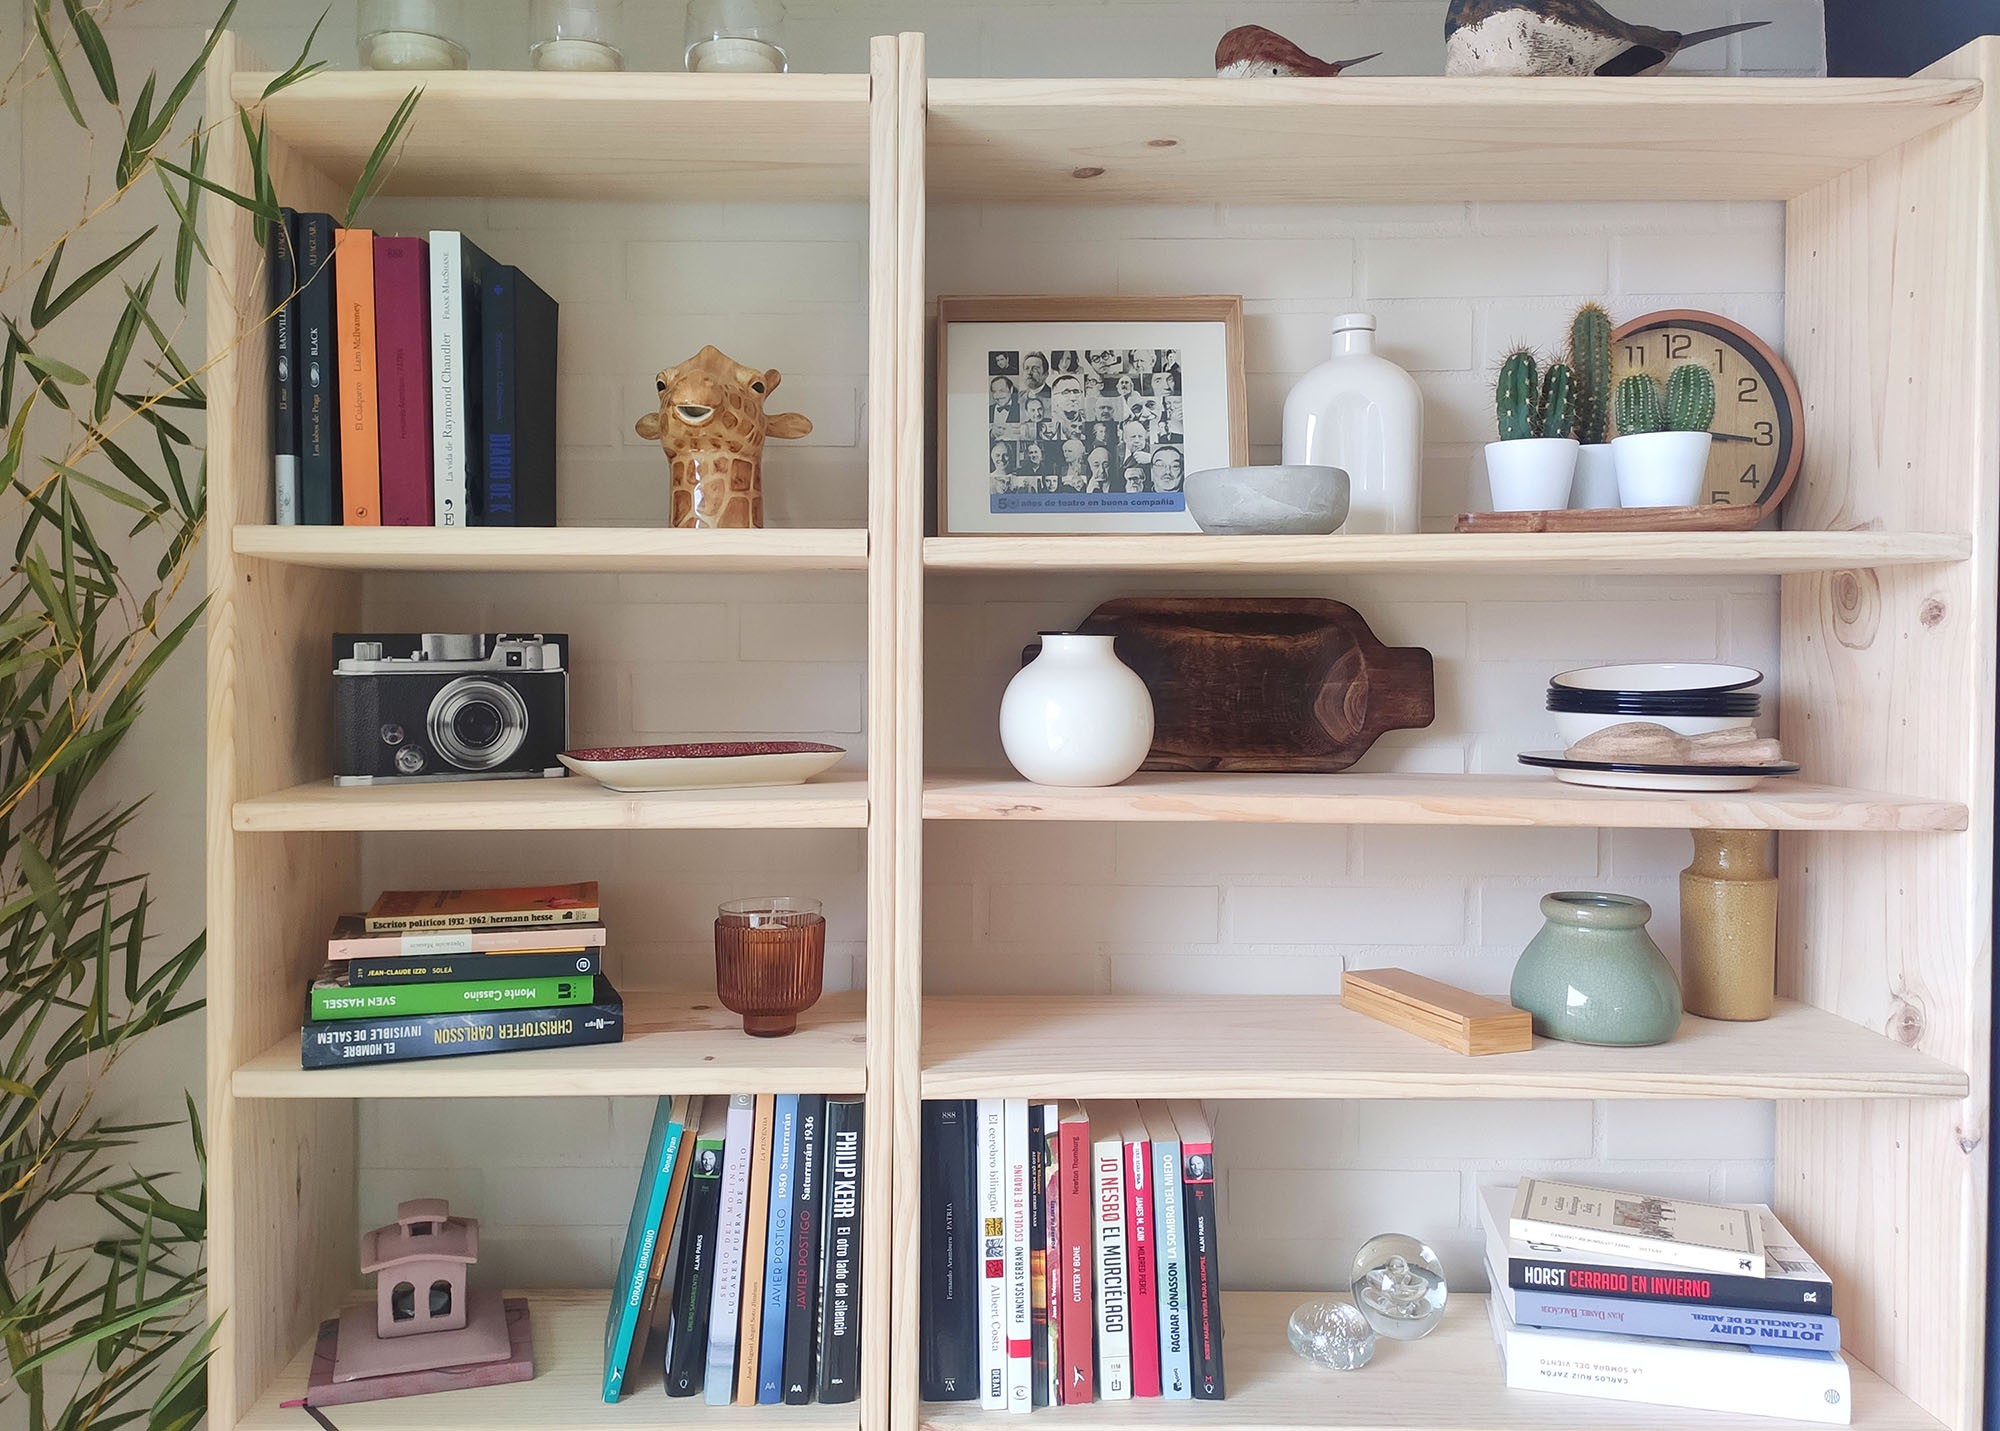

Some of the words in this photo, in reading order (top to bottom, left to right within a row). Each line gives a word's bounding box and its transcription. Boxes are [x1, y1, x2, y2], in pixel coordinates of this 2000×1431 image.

[352, 302, 361, 350] McIlvanney
[310, 328, 318, 355] BLACK
[1663, 334, 1692, 359] 12
[353, 353, 361, 371] Liam
[441, 333, 451, 383] Chandler
[1625, 346, 1644, 367] 11
[1715, 349, 1723, 374] 1
[1738, 378, 1758, 402] 2
[312, 394, 320, 413] Praga
[442, 386, 455, 438] Raymond
[312, 415, 319, 423] de
[312, 425, 320, 440] lobos
[1753, 422, 1773, 446] 3
[445, 442, 453, 451] de
[445, 453, 453, 470] vida
[489, 434, 511, 479] DIARIO
[446, 472, 453, 482] La
[1740, 464, 1760, 488] 4
[489, 483, 511, 499] DE
[1131, 499, 1174, 507] compañía
[373, 918, 407, 929] Escritos
[409, 917, 446, 929] políticos
[490, 913, 529, 924] hermann
[532, 913, 553, 922] hesse
[367, 967, 412, 977] JEAN-CLAUDE
[413, 967, 427, 975] IZZO
[323, 997, 364, 1009] HASSEL
[368, 996, 396, 1007] SVEN
[464, 989, 502, 1001] Cassino
[504, 988, 536, 999] Monte
[317, 1030, 352, 1045] SALEM
[354, 1029, 367, 1042] DE
[370, 1026, 421, 1040] INVISIBLE
[434, 1025, 494, 1044] CARLSSON
[499, 1019, 573, 1039] CHRISTOFFER
[344, 1044, 381, 1058] HOMBRE
[383, 1043, 395, 1055] EL
[804, 1116, 814, 1140] 1936
[988, 1114, 998, 1125] El
[666, 1136, 677, 1153] Ryan
[779, 1113, 792, 1170] Saturrarán
[988, 1128, 997, 1165] cerebro
[662, 1154, 674, 1173] Donal
[836, 1132, 858, 1177] PHILIP
[738, 1147, 747, 1182] SITIO
[801, 1144, 813, 1200] Saturrarán
[1100, 1157, 1117, 1173] JO
[1163, 1154, 1174, 1185] MIEDO
[725, 1162, 737, 1213] MOLINO
[778, 1174, 788, 1199] 1950
[1013, 1164, 1023, 1196] TRADING
[736, 1190, 744, 1204] DE
[834, 1180, 856, 1218] KERR
[987, 1169, 999, 1212] bilingüe
[1101, 1177, 1121, 1221] NESBØ
[1164, 1187, 1175, 1204] DEL
[1014, 1198, 1023, 1208] DE
[1135, 1196, 1144, 1216] JAMES
[732, 1212, 742, 1251] FUERA
[1013, 1209, 1024, 1242] ESCUELA
[1136, 1218, 1144, 1227] M.
[1166, 1205, 1177, 1248] SOMBRA
[724, 1230, 732, 1243] DEL
[774, 1208, 786, 1264] POSTIGO
[798, 1210, 810, 1265] POSTIGO
[1103, 1227, 1121, 1240] EL
[1136, 1227, 1144, 1241] CAIN
[694, 1234, 703, 1254] PARKS
[837, 1238, 848, 1256] otro
[694, 1255, 702, 1271] ALAN
[1014, 1246, 1024, 1280] SERRANO
[1138, 1246, 1147, 1273] MILDRED
[1167, 1250, 1177, 1259] LA
[630, 1270, 646, 1306] CORAZÓN
[638, 1230, 655, 1269] GIRATORIO
[720, 1252, 730, 1298] SERGIO
[836, 1260, 848, 1279] lado
[728, 1259, 739, 1314] LUGARES
[772, 1268, 783, 1307] JAVIER
[796, 1270, 808, 1310] JAVIER
[835, 1282, 847, 1296] del
[1073, 1274, 1081, 1302] CUTTER
[1104, 1246, 1126, 1332] MURCIÉLAGO
[1139, 1275, 1147, 1295] PIERCE
[1166, 1262, 1179, 1312] JÓNASSON
[1524, 1265, 1565, 1287] HORST
[1569, 1269, 1628, 1292] CERRADO
[1631, 1276, 1647, 1293] EN
[1651, 1277, 1711, 1298] INVIERNO
[688, 1274, 699, 1311] SANGRIENTO
[990, 1285, 1000, 1314] Albert
[1014, 1282, 1025, 1323] FRANCISCA
[687, 1313, 696, 1332] ENERO
[833, 1300, 845, 1335] silencio
[1691, 1313, 1724, 1323] ABRIL
[1726, 1315, 1742, 1324] DE
[1744, 1317, 1806, 1329] CANCILLER
[1809, 1322, 1823, 1330] EL
[990, 1321, 999, 1351] Costa
[1168, 1314, 1181, 1352] RAGNAR
[1710, 1323, 1756, 1336] CURY
[1759, 1327, 1824, 1342] JOTTIN
[1539, 1358, 1571, 1368] VIENTO
[1573, 1361, 1590, 1370] DEL
[1593, 1363, 1628, 1374] SOMBRA
[1630, 1367, 1643, 1375] LA
[992, 1369, 1001, 1397] DEBATE
[1539, 1369, 1568, 1380] ZAFÓN
[1572, 1372, 1592, 1381] RUIZ
[1594, 1374, 1629, 1385] CARLOS
